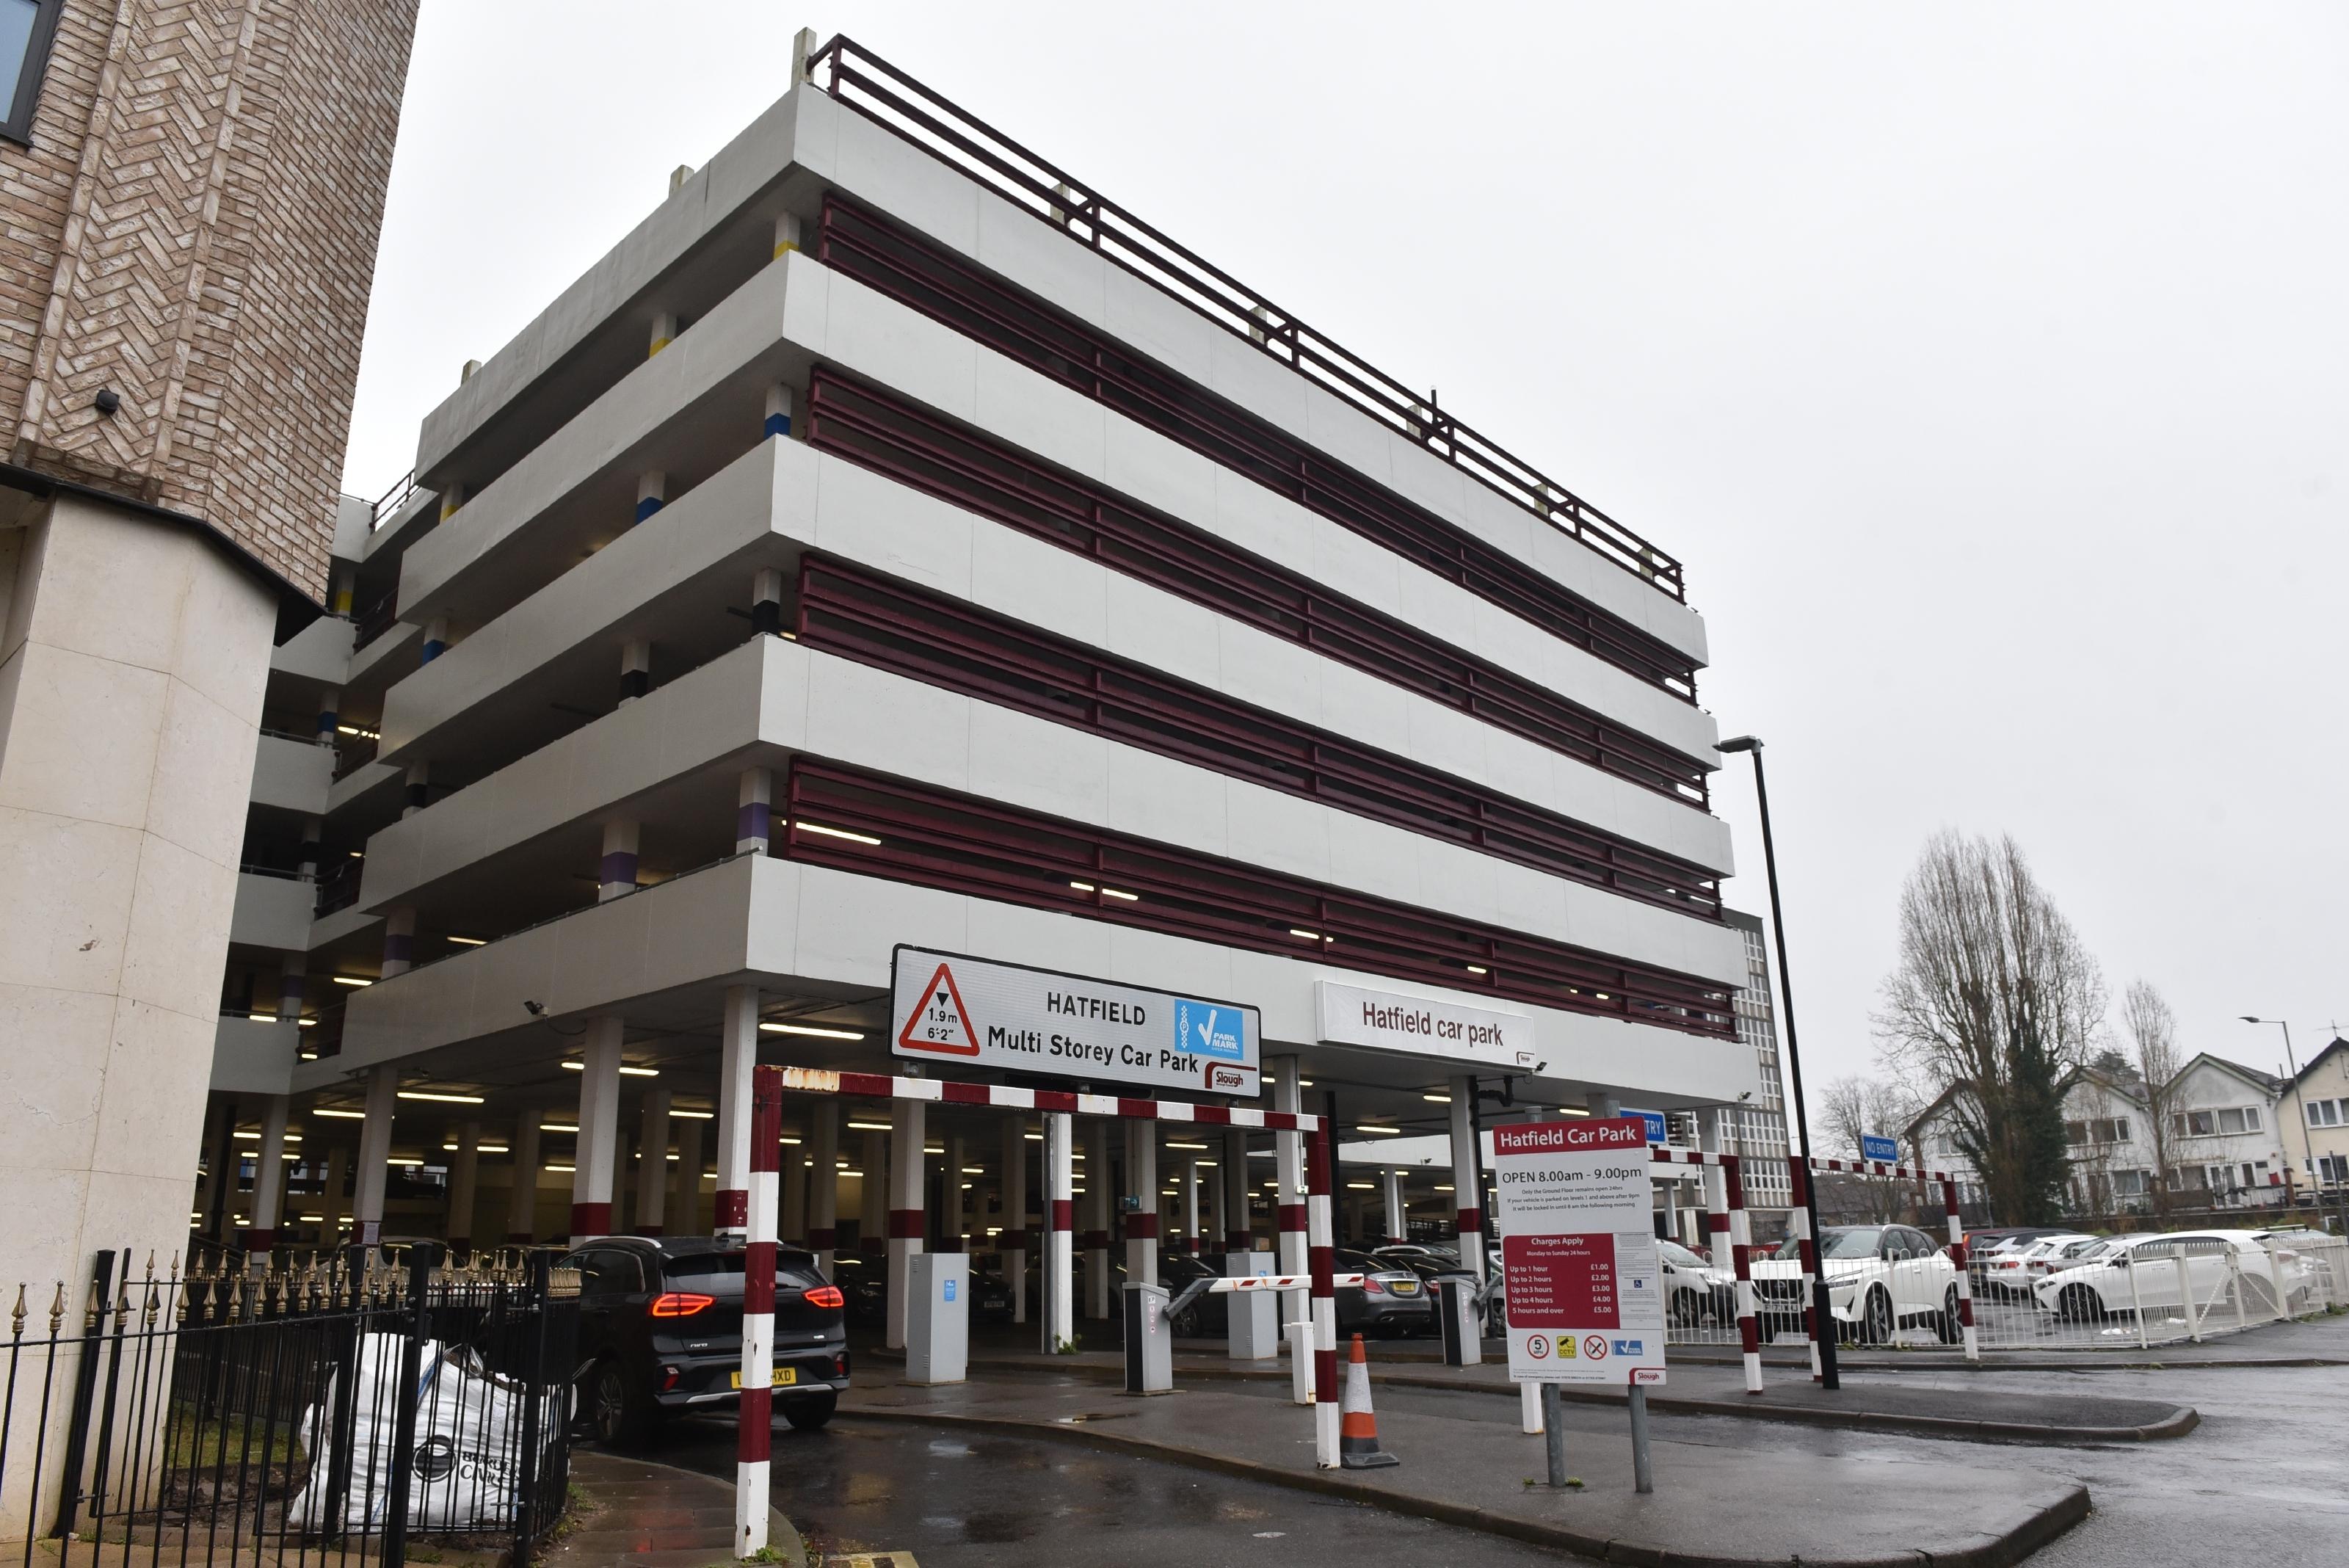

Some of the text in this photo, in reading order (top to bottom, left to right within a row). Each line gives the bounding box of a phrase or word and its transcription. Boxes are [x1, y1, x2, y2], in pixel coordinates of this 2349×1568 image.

[1048, 992, 1145, 1026] HATFIELD
[1362, 1001, 1503, 1048] Hatfield car park
[1213, 1033, 1235, 1042] PARK
[988, 1026, 1198, 1072] Multi Storey Car Park
[1212, 1039, 1238, 1050] MARK
[1216, 1071, 1243, 1086] Slough
[1644, 1120, 1660, 1135] TRY
[1500, 1125, 1636, 1147] Hatfield Car Park
[1865, 1141, 1895, 1156] NO ENTRY
[1503, 1172, 1535, 1183] OPEN
[1539, 1170, 1583, 1182] 8.00am
[1594, 1168, 1641, 1180] 9.00pm
[1531, 1237, 1583, 1246] Charges Apply
[1511, 1276, 1520, 1284] Up
[1511, 1286, 1520, 1294] Up
[1534, 1340, 1542, 1350] 5
[772, 1370, 791, 1382] HXD
[1638, 1372, 1660, 1381] Slough
